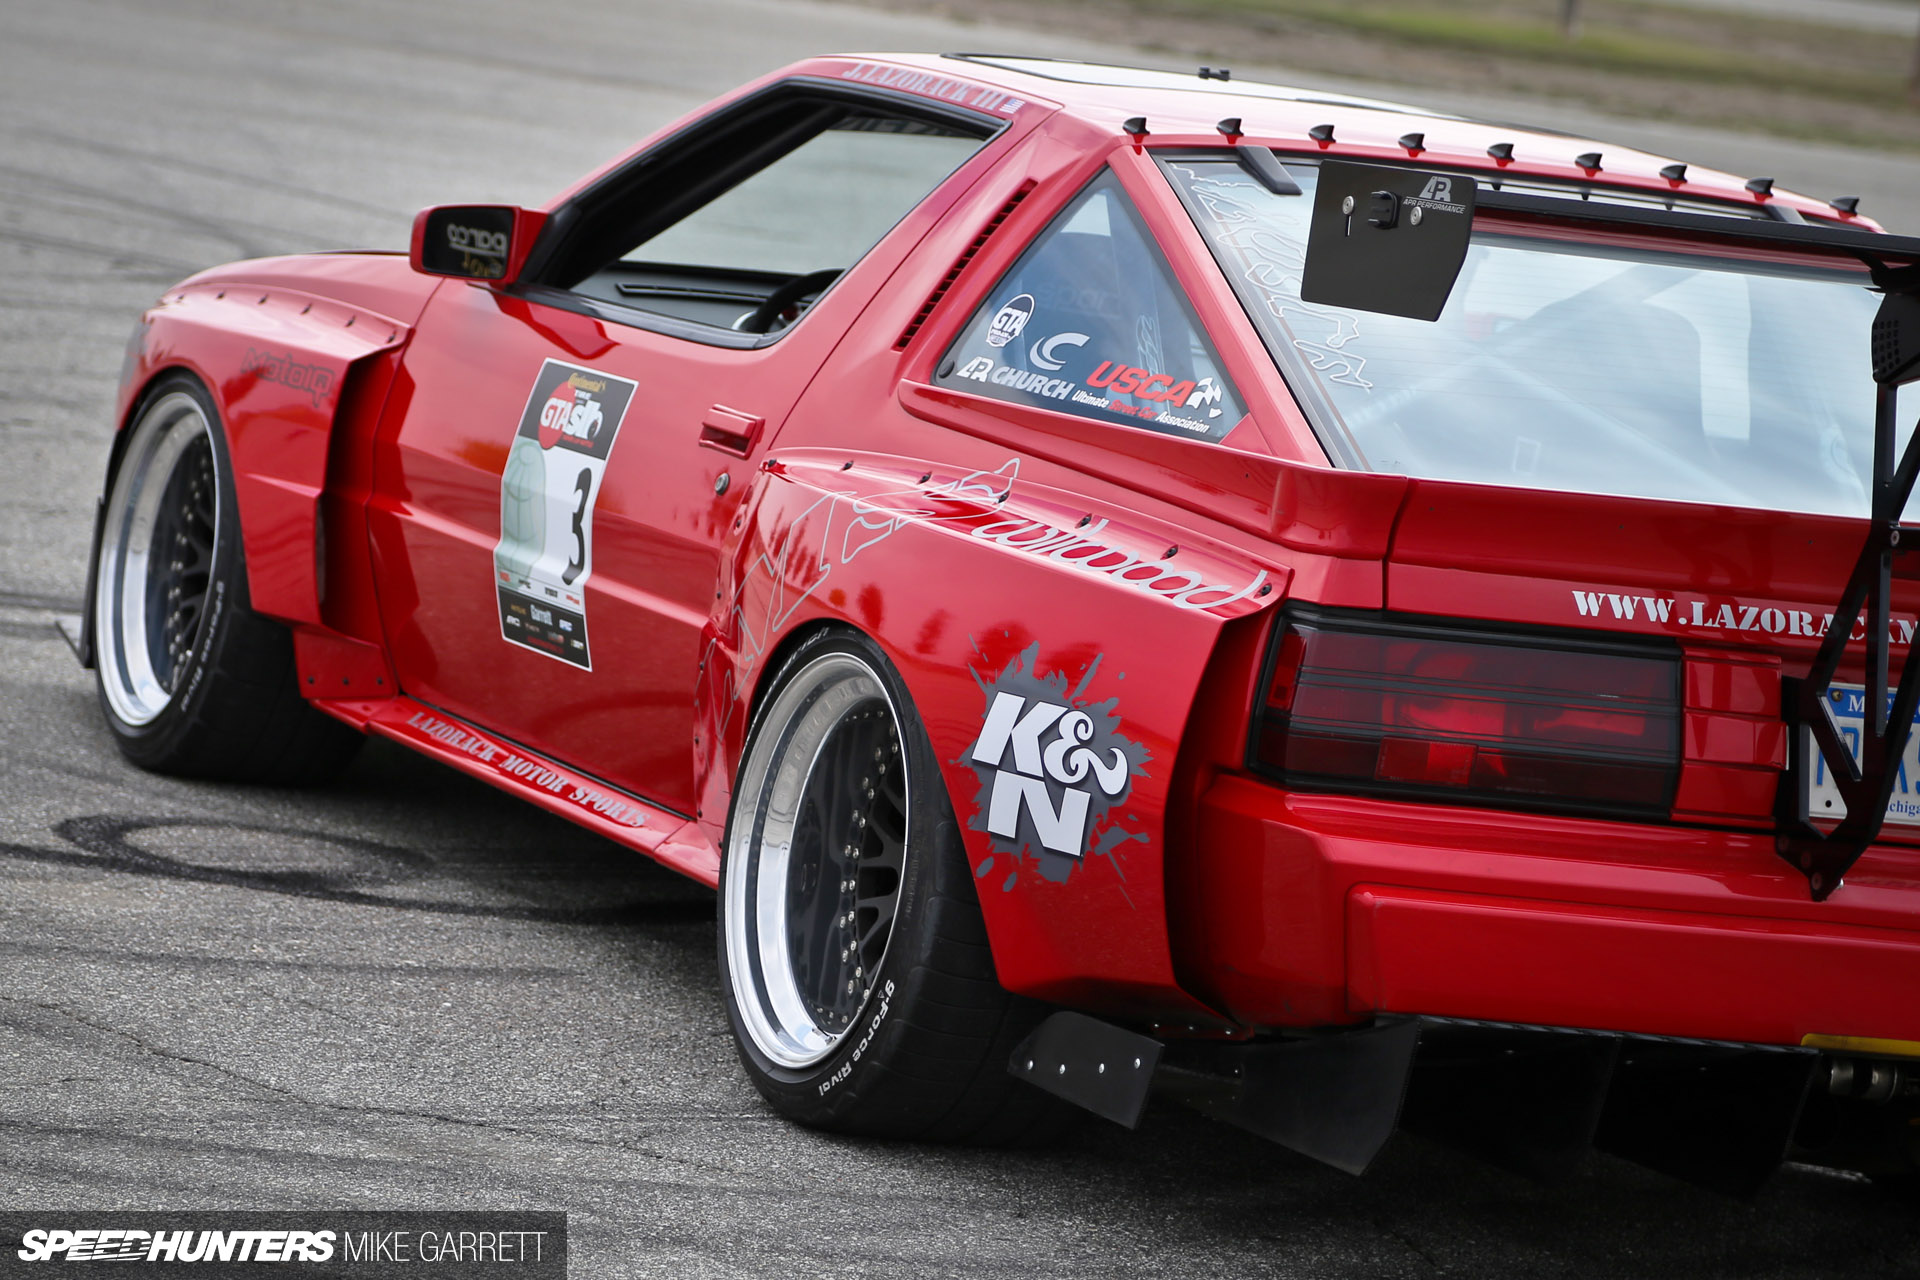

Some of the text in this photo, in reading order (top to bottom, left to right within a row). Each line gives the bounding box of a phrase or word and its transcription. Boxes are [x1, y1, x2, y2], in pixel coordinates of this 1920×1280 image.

[1403, 198, 1466, 214] APR PERFORMANCE
[992, 307, 1029, 337] GTA
[991, 366, 1076, 400] CHURCH
[1086, 361, 1196, 408] USCA
[1071, 389, 1110, 408] Ultimate
[1154, 411, 1210, 433] Association
[562, 467, 592, 586] 3
[407, 711, 650, 828] LAZORACK MOTOR SPORTS
[818, 1061, 852, 1096] Rival
